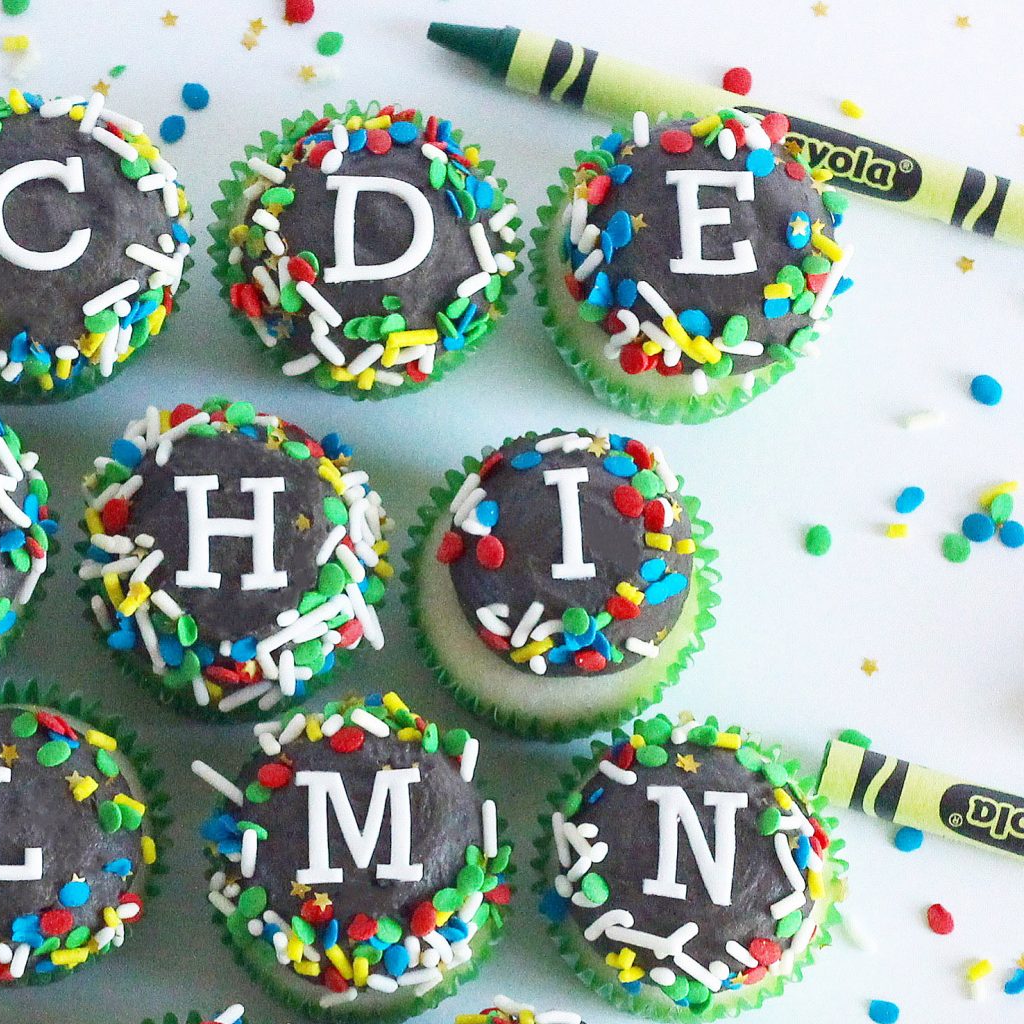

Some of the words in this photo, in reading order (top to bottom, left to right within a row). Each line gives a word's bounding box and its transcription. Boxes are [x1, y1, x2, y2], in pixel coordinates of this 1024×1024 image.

[324, 176, 434, 283] D
[666, 170, 757, 275] E
[175, 475, 287, 590] H
[544, 467, 596, 580] I
[296, 764, 423, 884] M
[643, 786, 748, 906] N
